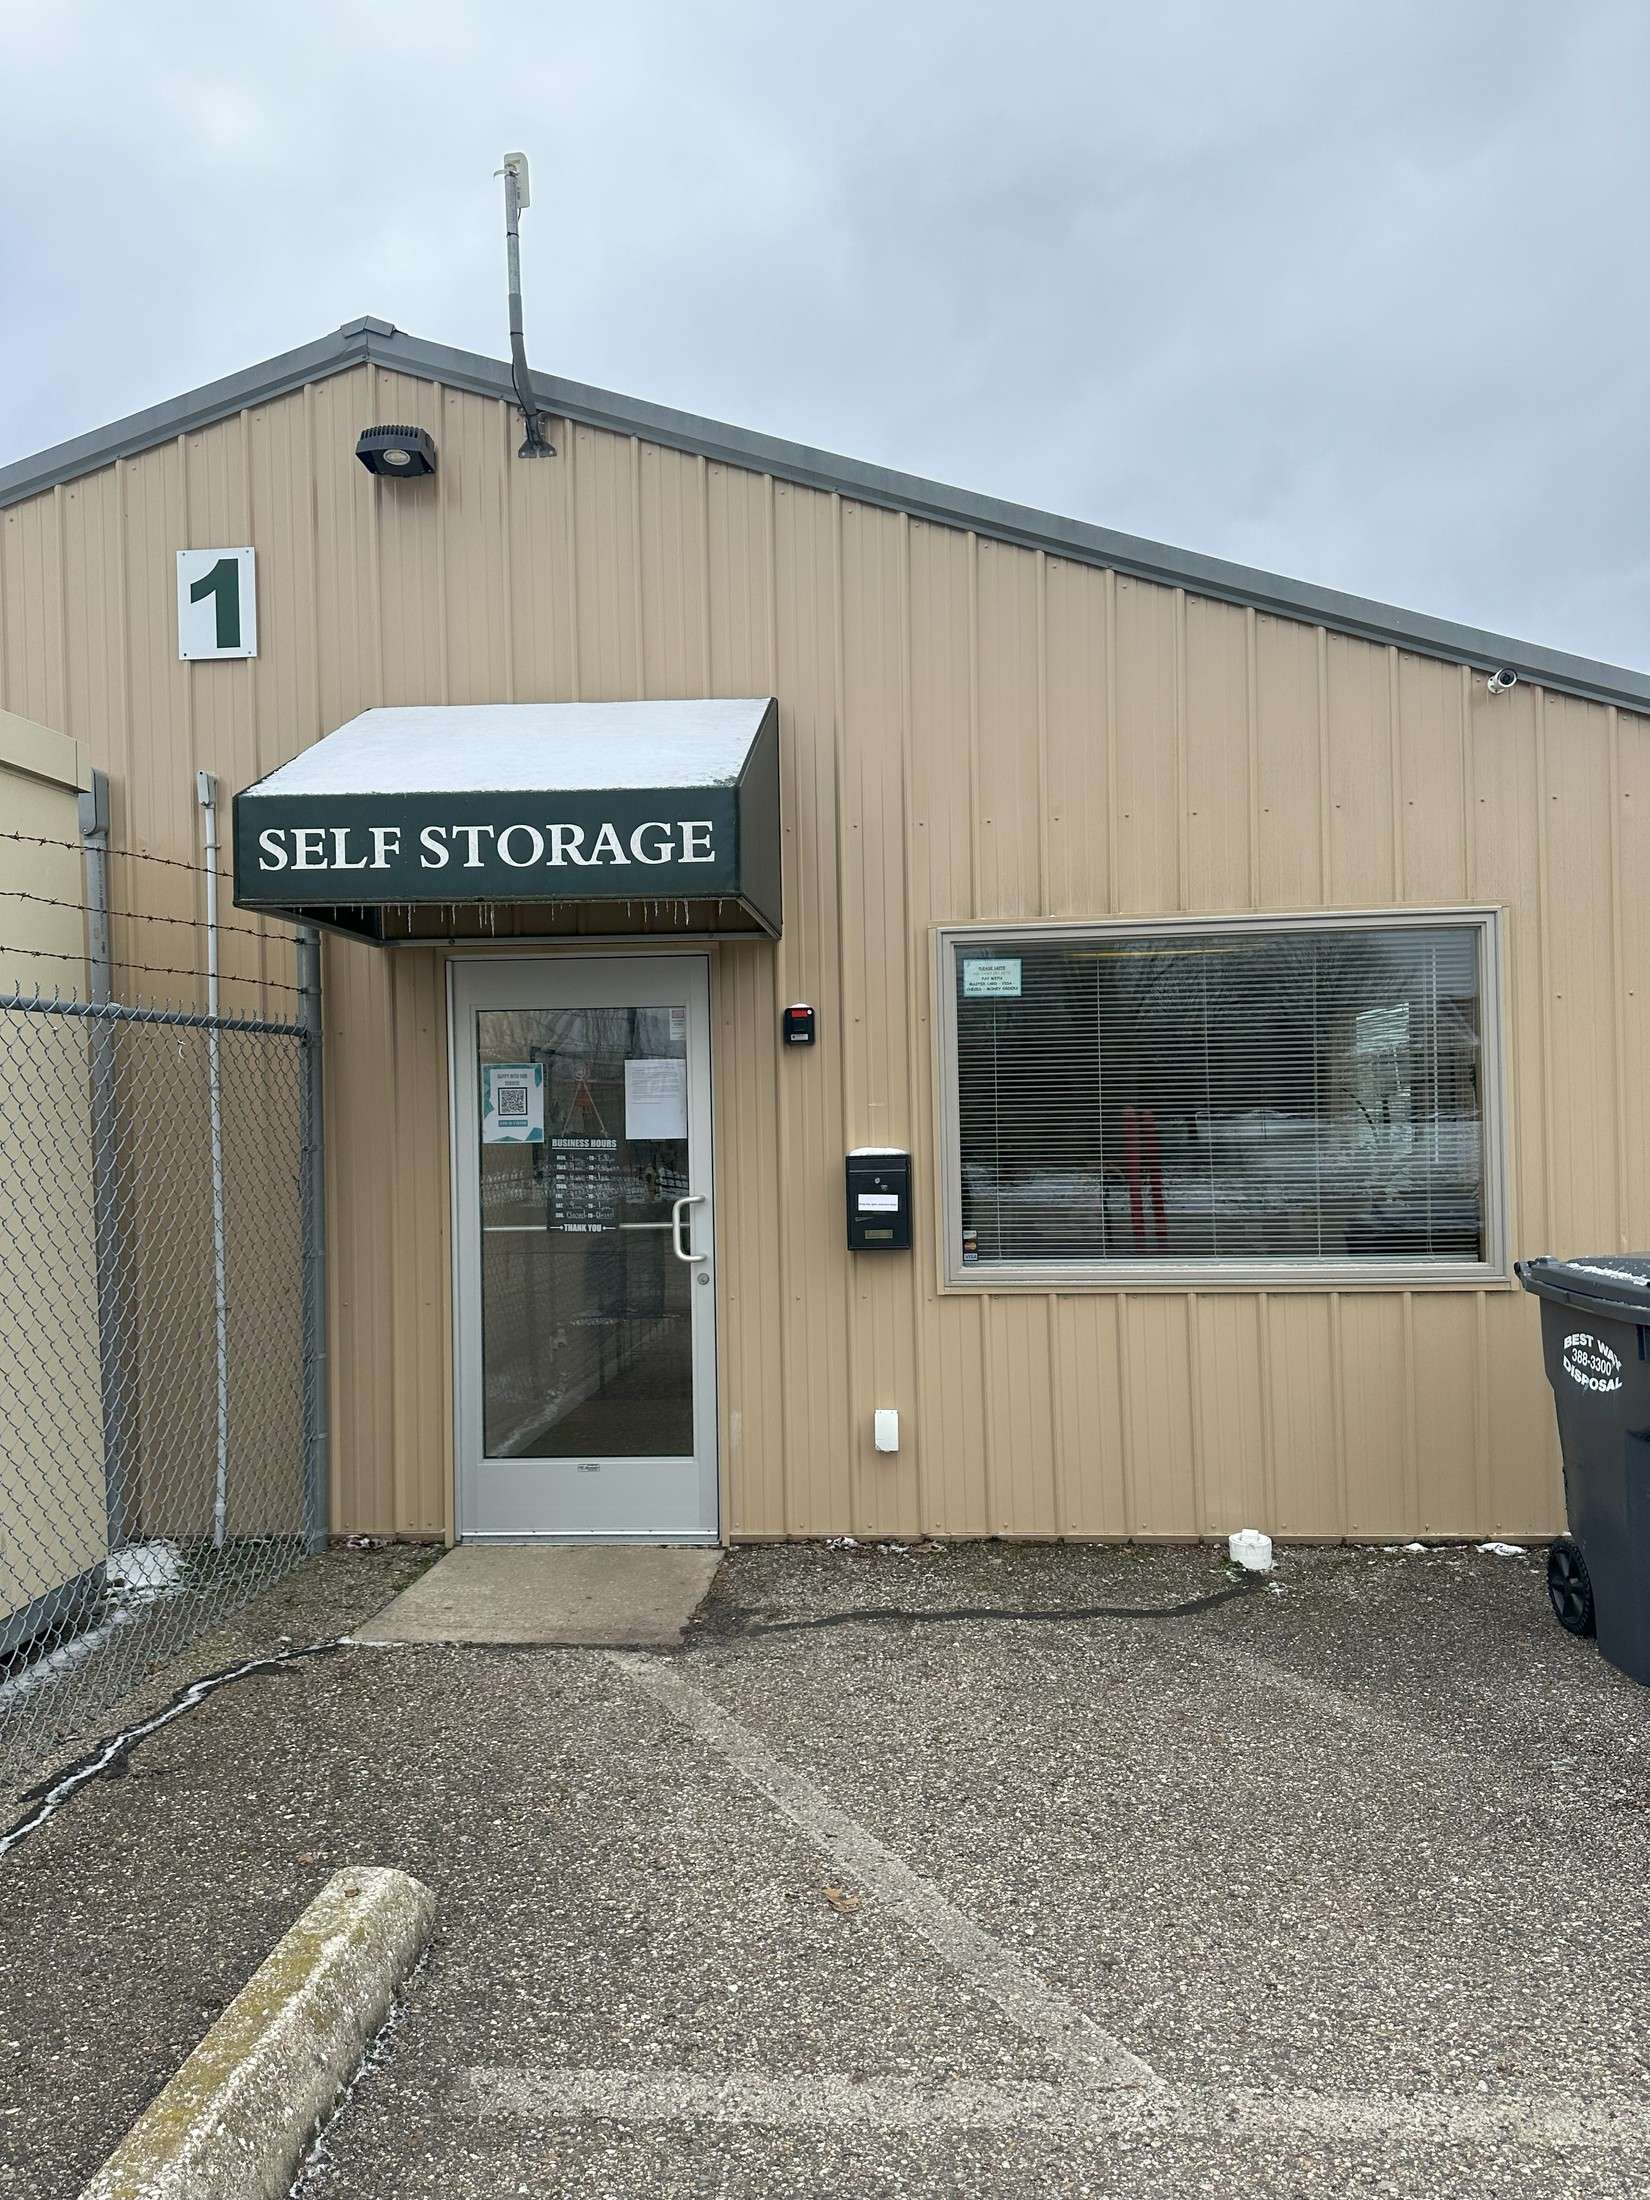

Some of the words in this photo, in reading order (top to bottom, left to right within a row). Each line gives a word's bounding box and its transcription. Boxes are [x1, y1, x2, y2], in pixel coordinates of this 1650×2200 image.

[190, 558, 241, 648] 1
[258, 827, 401, 871] SELF
[419, 820, 716, 869] STORAGE
[552, 1138, 590, 1148] BUSINESS
[590, 1139, 617, 1148] HOURS
[563, 1224, 587, 1232] THANK
[587, 1223, 602, 1232] YOU
[1563, 1333, 1594, 1349] BEST
[1597, 1339, 1622, 1372] WAY
[1571, 1347, 1612, 1377] 388-3300
[1563, 1354, 1623, 1393] DISPOSAL
